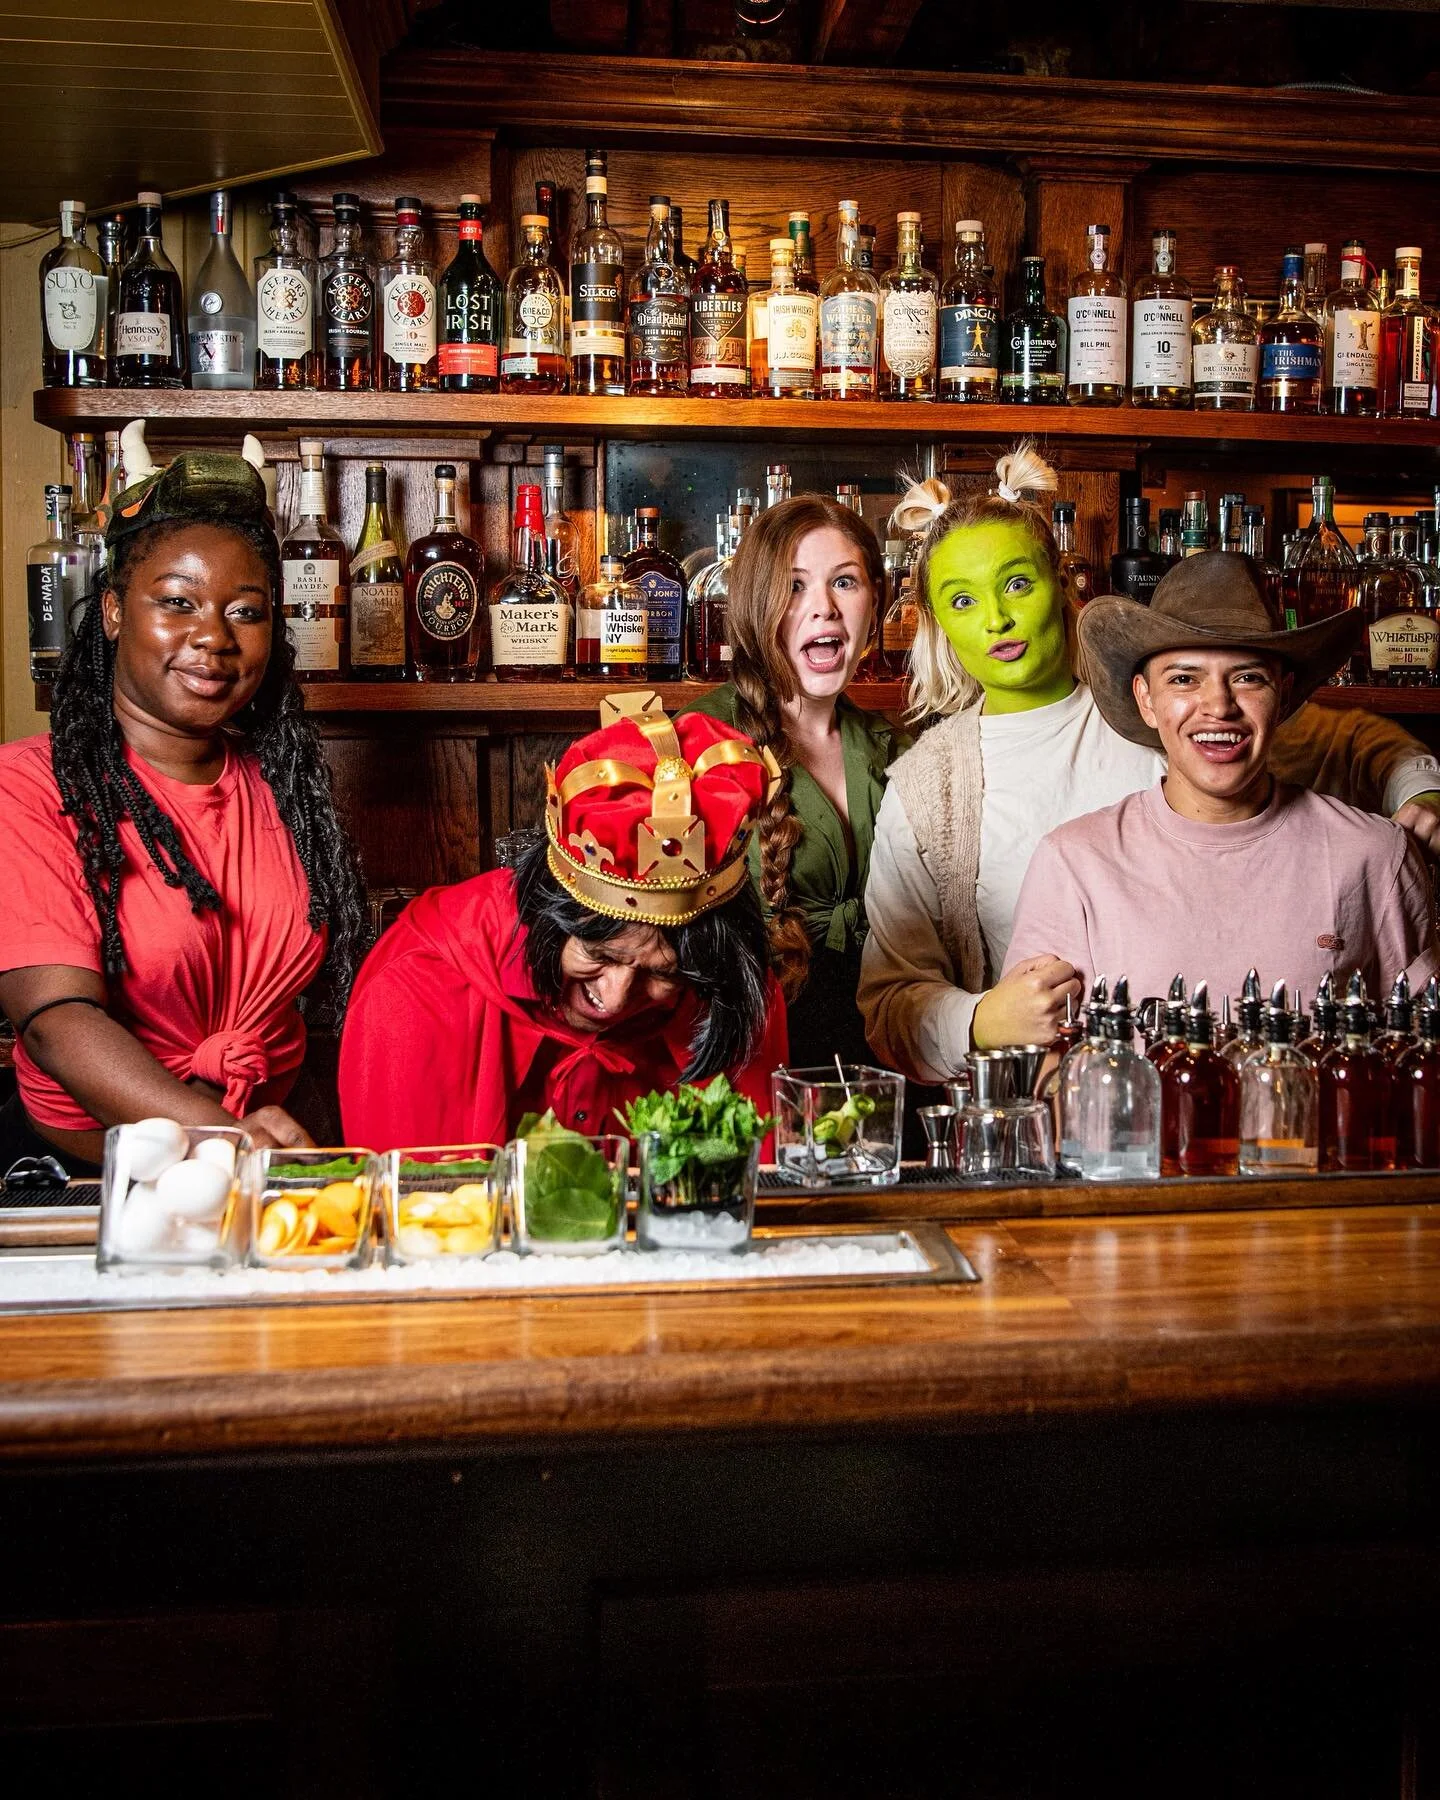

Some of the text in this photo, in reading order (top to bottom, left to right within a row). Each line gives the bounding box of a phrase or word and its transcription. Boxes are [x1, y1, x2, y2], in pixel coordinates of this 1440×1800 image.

[47, 272, 94, 289] SUYO
[264, 276, 306, 298] KEEPER'S
[328, 276, 370, 298] KEEPER'S
[391, 282, 432, 304] KEEPER'S
[580, 284, 617, 298] SILKIE
[448, 294, 490, 310] LOST
[694, 300, 742, 313] LIBERTIES
[266, 306, 304, 321] HEART
[331, 306, 368, 321] HEART
[522, 307, 550, 316] ROE&CO
[774, 305, 814, 316] IRISH WHISKEY
[954, 308, 997, 324] DINGLE
[394, 312, 430, 327] HEART
[446, 314, 492, 330] IRISH
[638, 312, 687, 328] Dead Rabbit
[826, 314, 872, 325] WHISTLER
[122, 325, 162, 336] Hennessy
[206, 332, 238, 343] MRTIN
[1010, 337, 1057, 349] Conemara
[1157, 341, 1170, 354] 10
[424, 572, 469, 600] MICHTER'S
[424, 611, 469, 632] BOURBON
[500, 610, 559, 620] Maker's
[606, 612, 643, 622] Hudson
[516, 622, 558, 632] Mark
[606, 623, 645, 634] Whiskey
[606, 634, 622, 643] NY
[1404, 653, 1413, 663] 10
